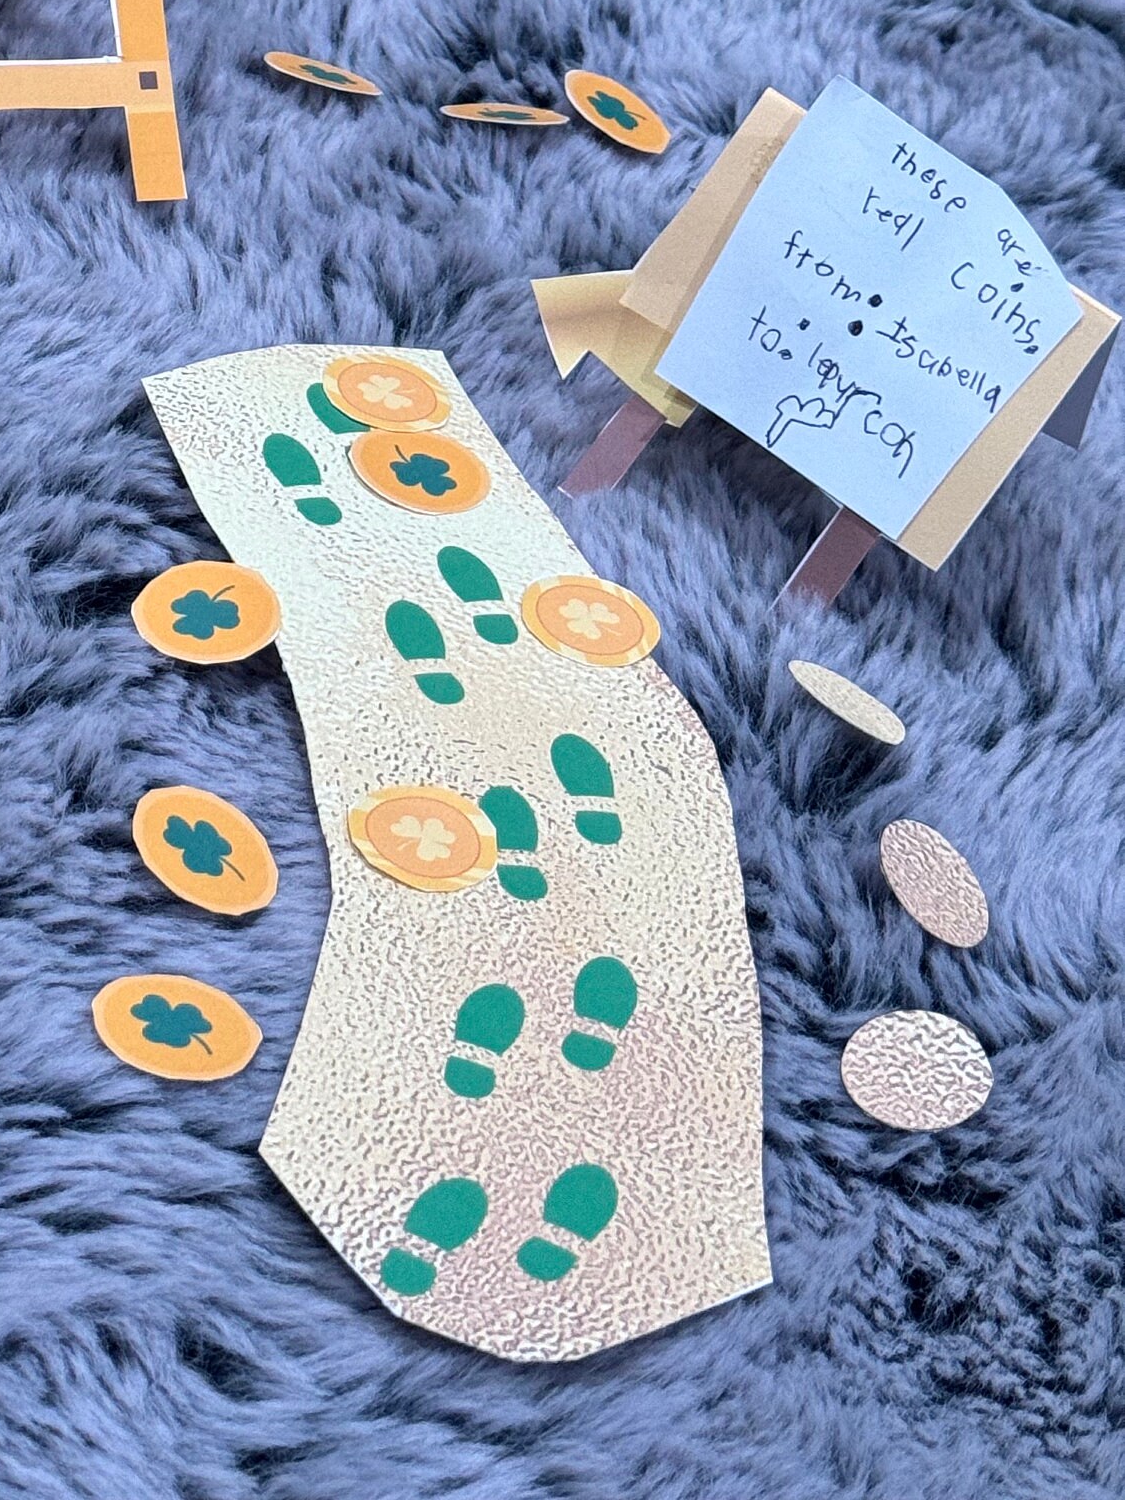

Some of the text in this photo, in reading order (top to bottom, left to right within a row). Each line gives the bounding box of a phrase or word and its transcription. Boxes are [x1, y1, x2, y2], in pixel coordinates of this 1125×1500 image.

[862, 186, 925, 252] real
[891, 141, 1037, 277] these are
